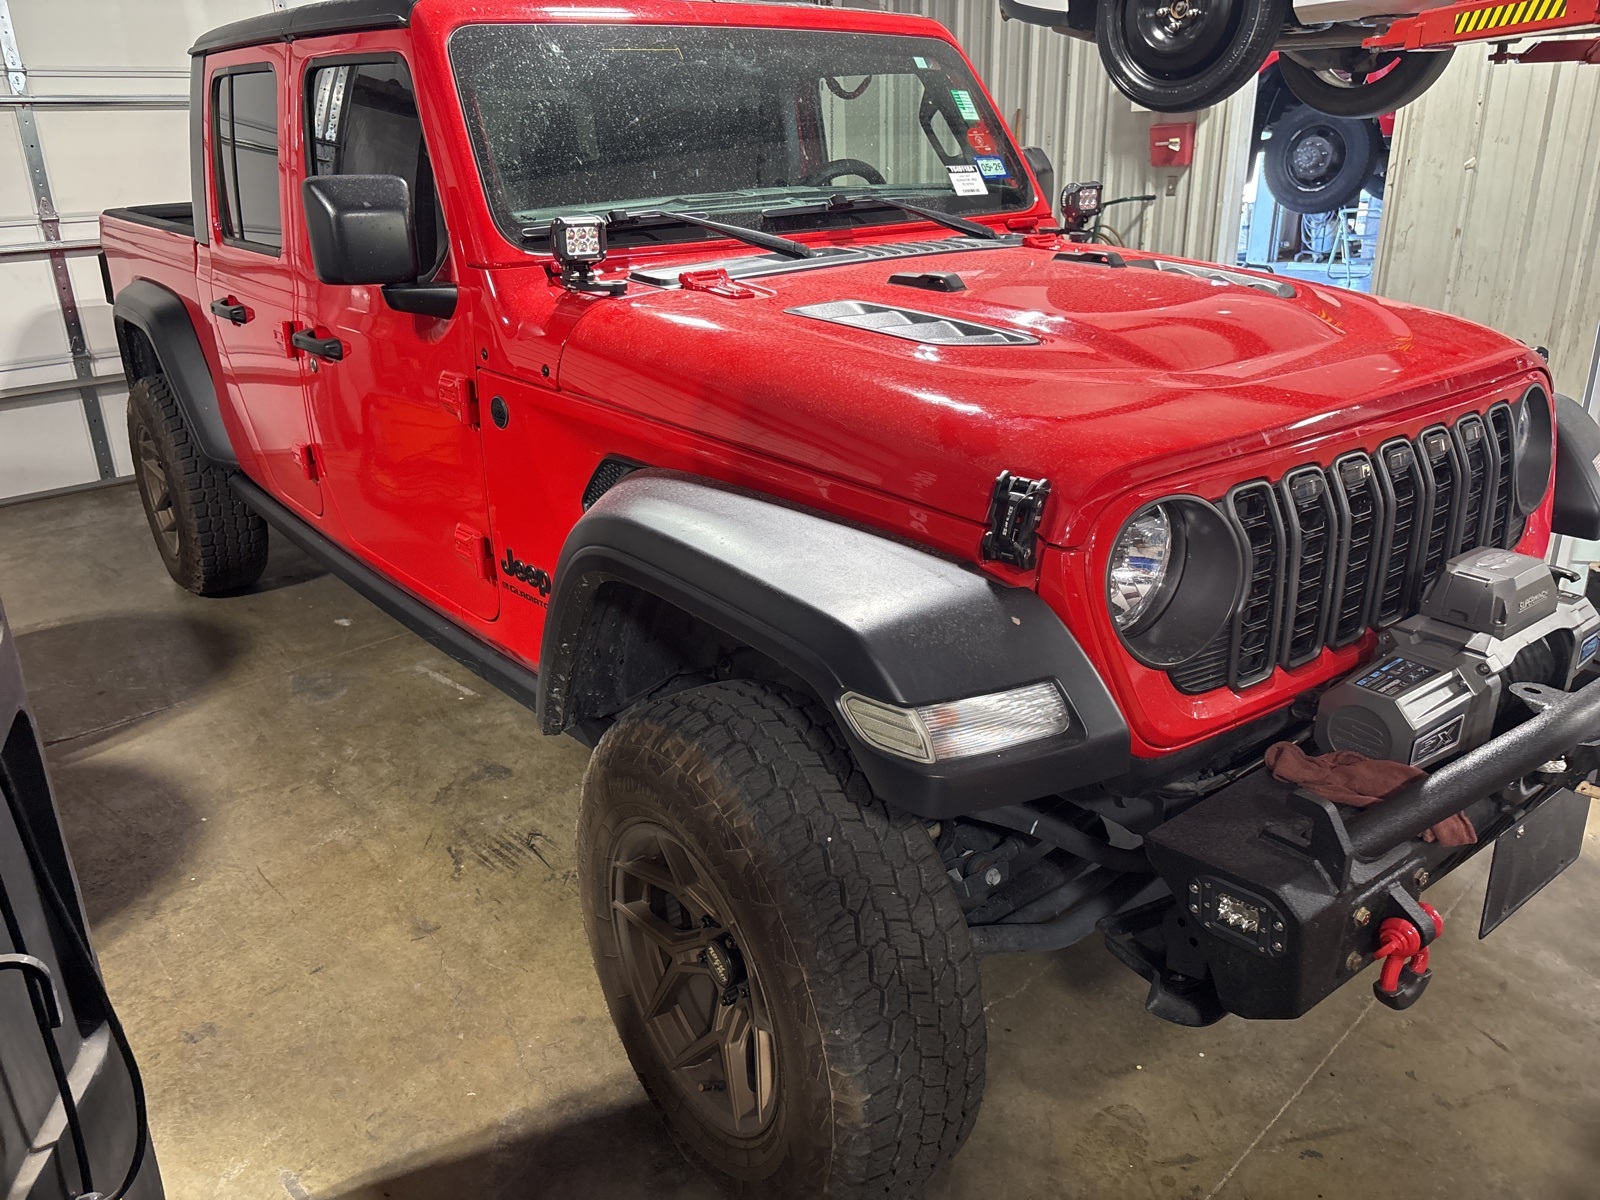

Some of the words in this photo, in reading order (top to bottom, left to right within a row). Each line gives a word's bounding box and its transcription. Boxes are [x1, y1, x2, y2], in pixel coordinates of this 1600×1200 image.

[980, 163, 991, 172] 05
[993, 162, 1003, 171] 26
[501, 547, 551, 597] Jeep
[510, 584, 548, 609] GLADIATO
